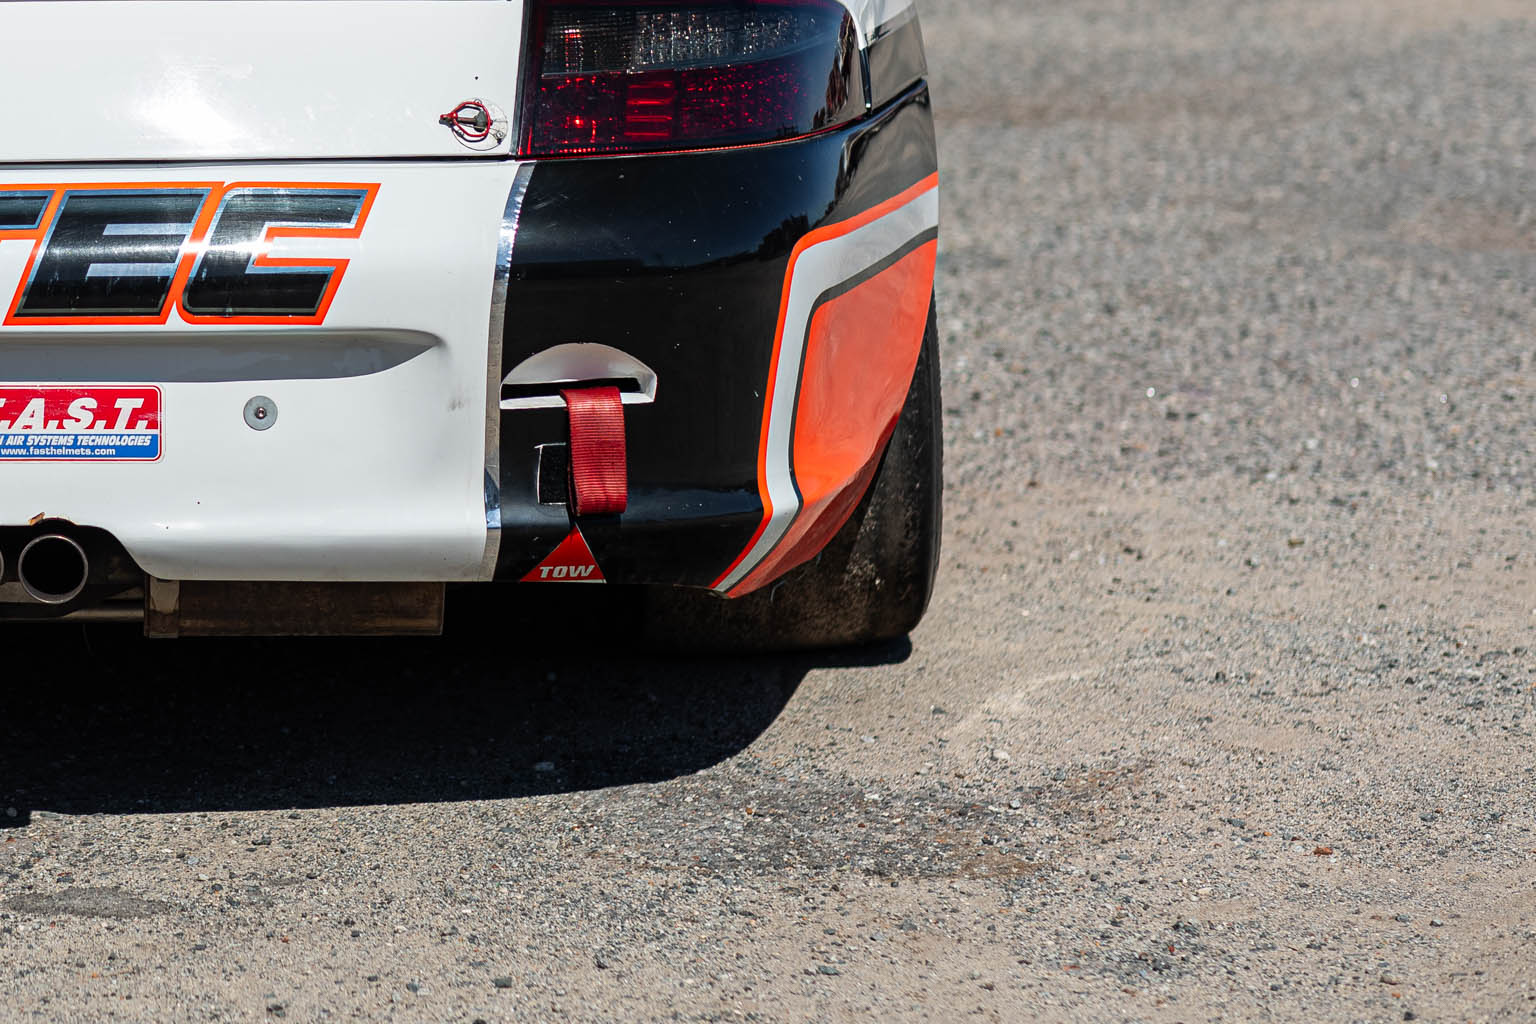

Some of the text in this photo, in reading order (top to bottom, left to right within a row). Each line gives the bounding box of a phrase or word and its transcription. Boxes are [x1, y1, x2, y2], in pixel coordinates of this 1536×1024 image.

[5, 435, 24, 446] AIR
[26, 435, 75, 446] SYSTEMS
[77, 435, 152, 446] TECHNOLOGIES
[0, 446, 117, 456] www.fasthelmets.com
[539, 565, 595, 578] TOW
